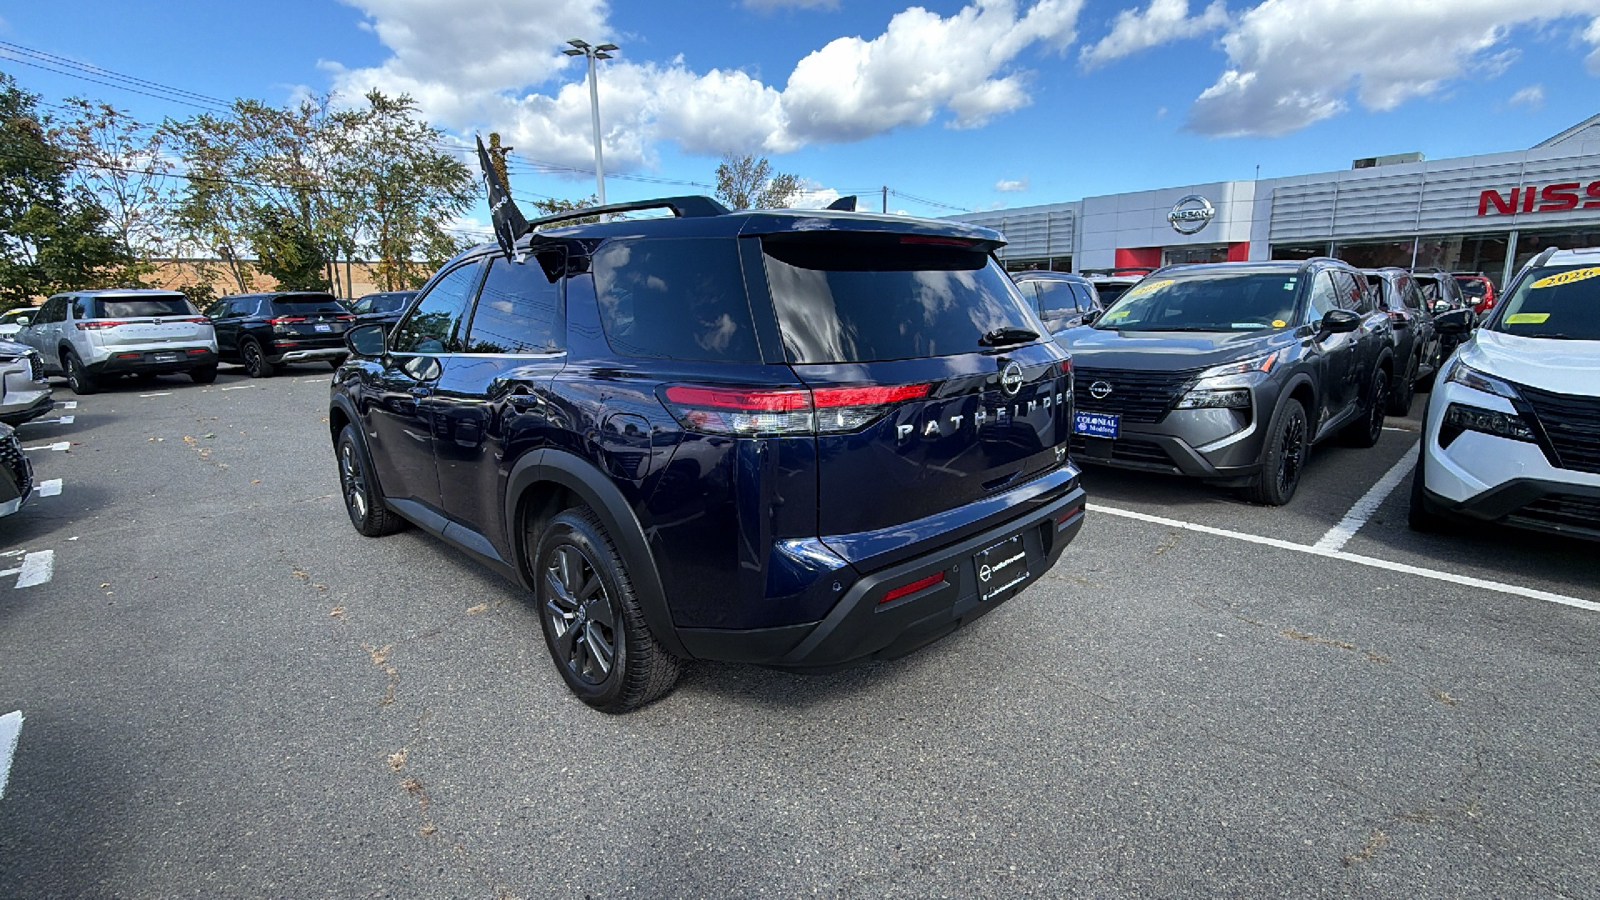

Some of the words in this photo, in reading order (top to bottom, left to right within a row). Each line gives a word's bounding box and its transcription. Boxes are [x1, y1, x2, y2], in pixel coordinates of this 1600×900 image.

[1171, 208, 1210, 220] NISSAN
[1547, 269, 1593, 286] 2026
[896, 389, 1072, 441] PATHFINDER
[1076, 416, 1117, 428] COLONIAL
